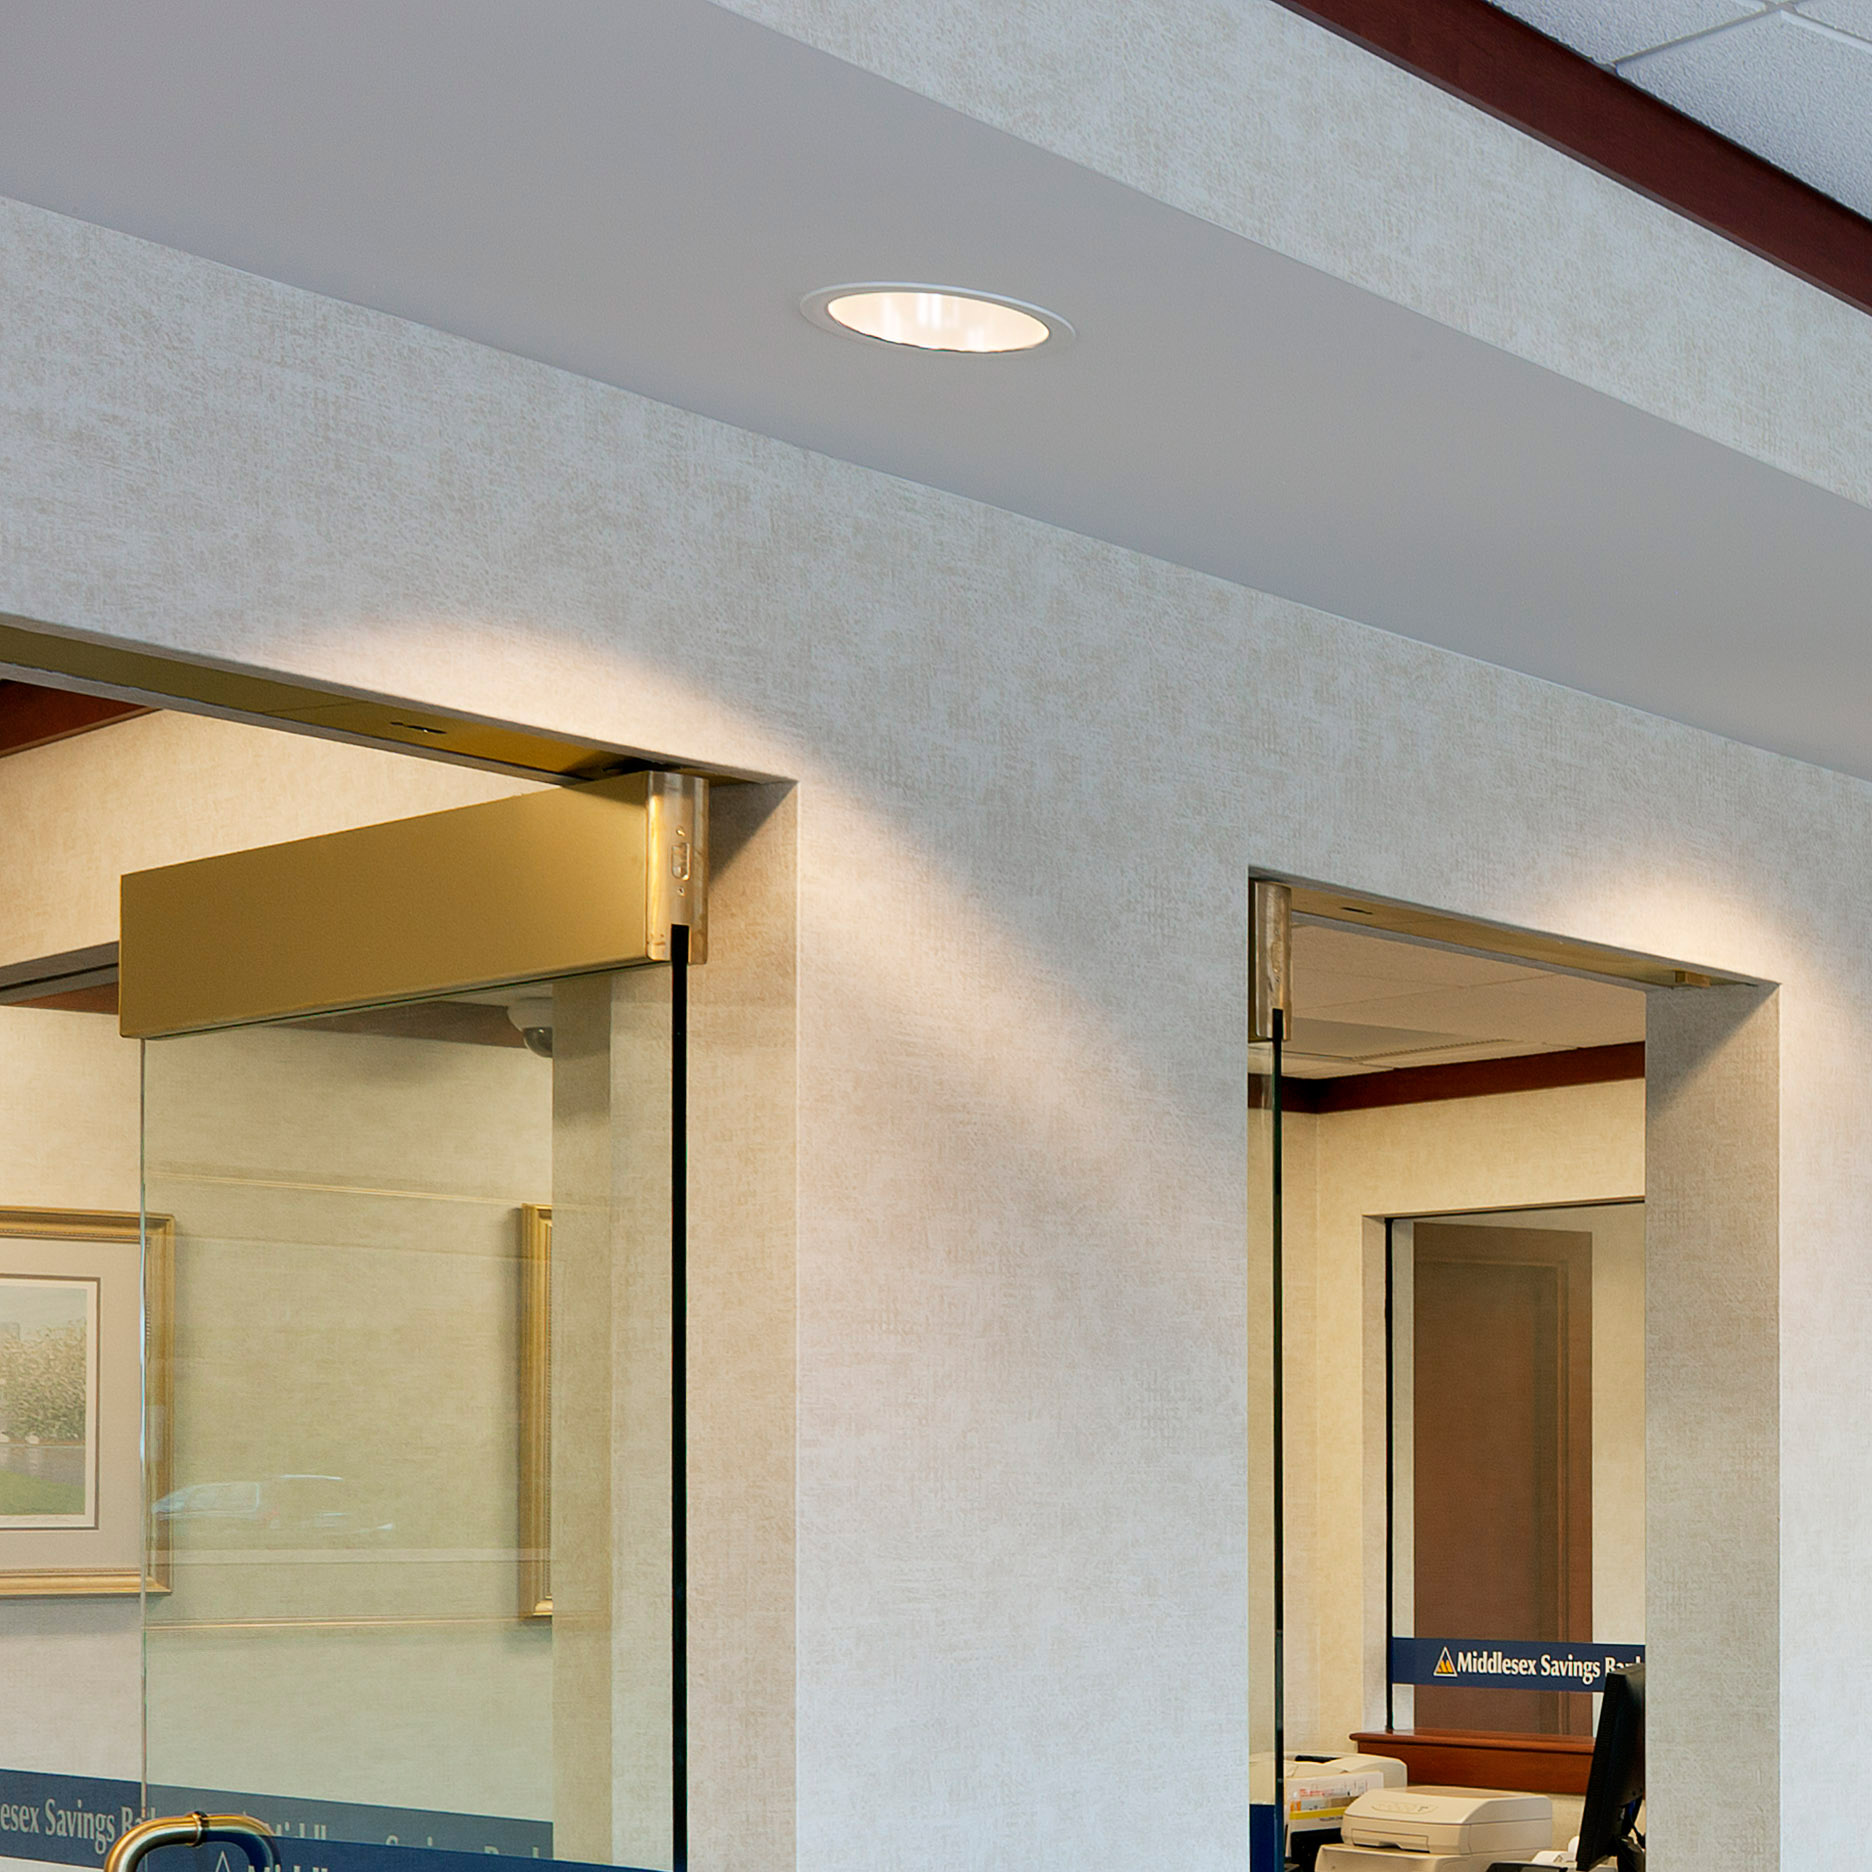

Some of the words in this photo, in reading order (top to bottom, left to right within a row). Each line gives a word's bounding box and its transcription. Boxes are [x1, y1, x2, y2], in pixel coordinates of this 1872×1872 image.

[1457, 1651, 1537, 1676] Middlesex
[1540, 1653, 1600, 1685] Savings
[45, 1798, 116, 1855] Savings
